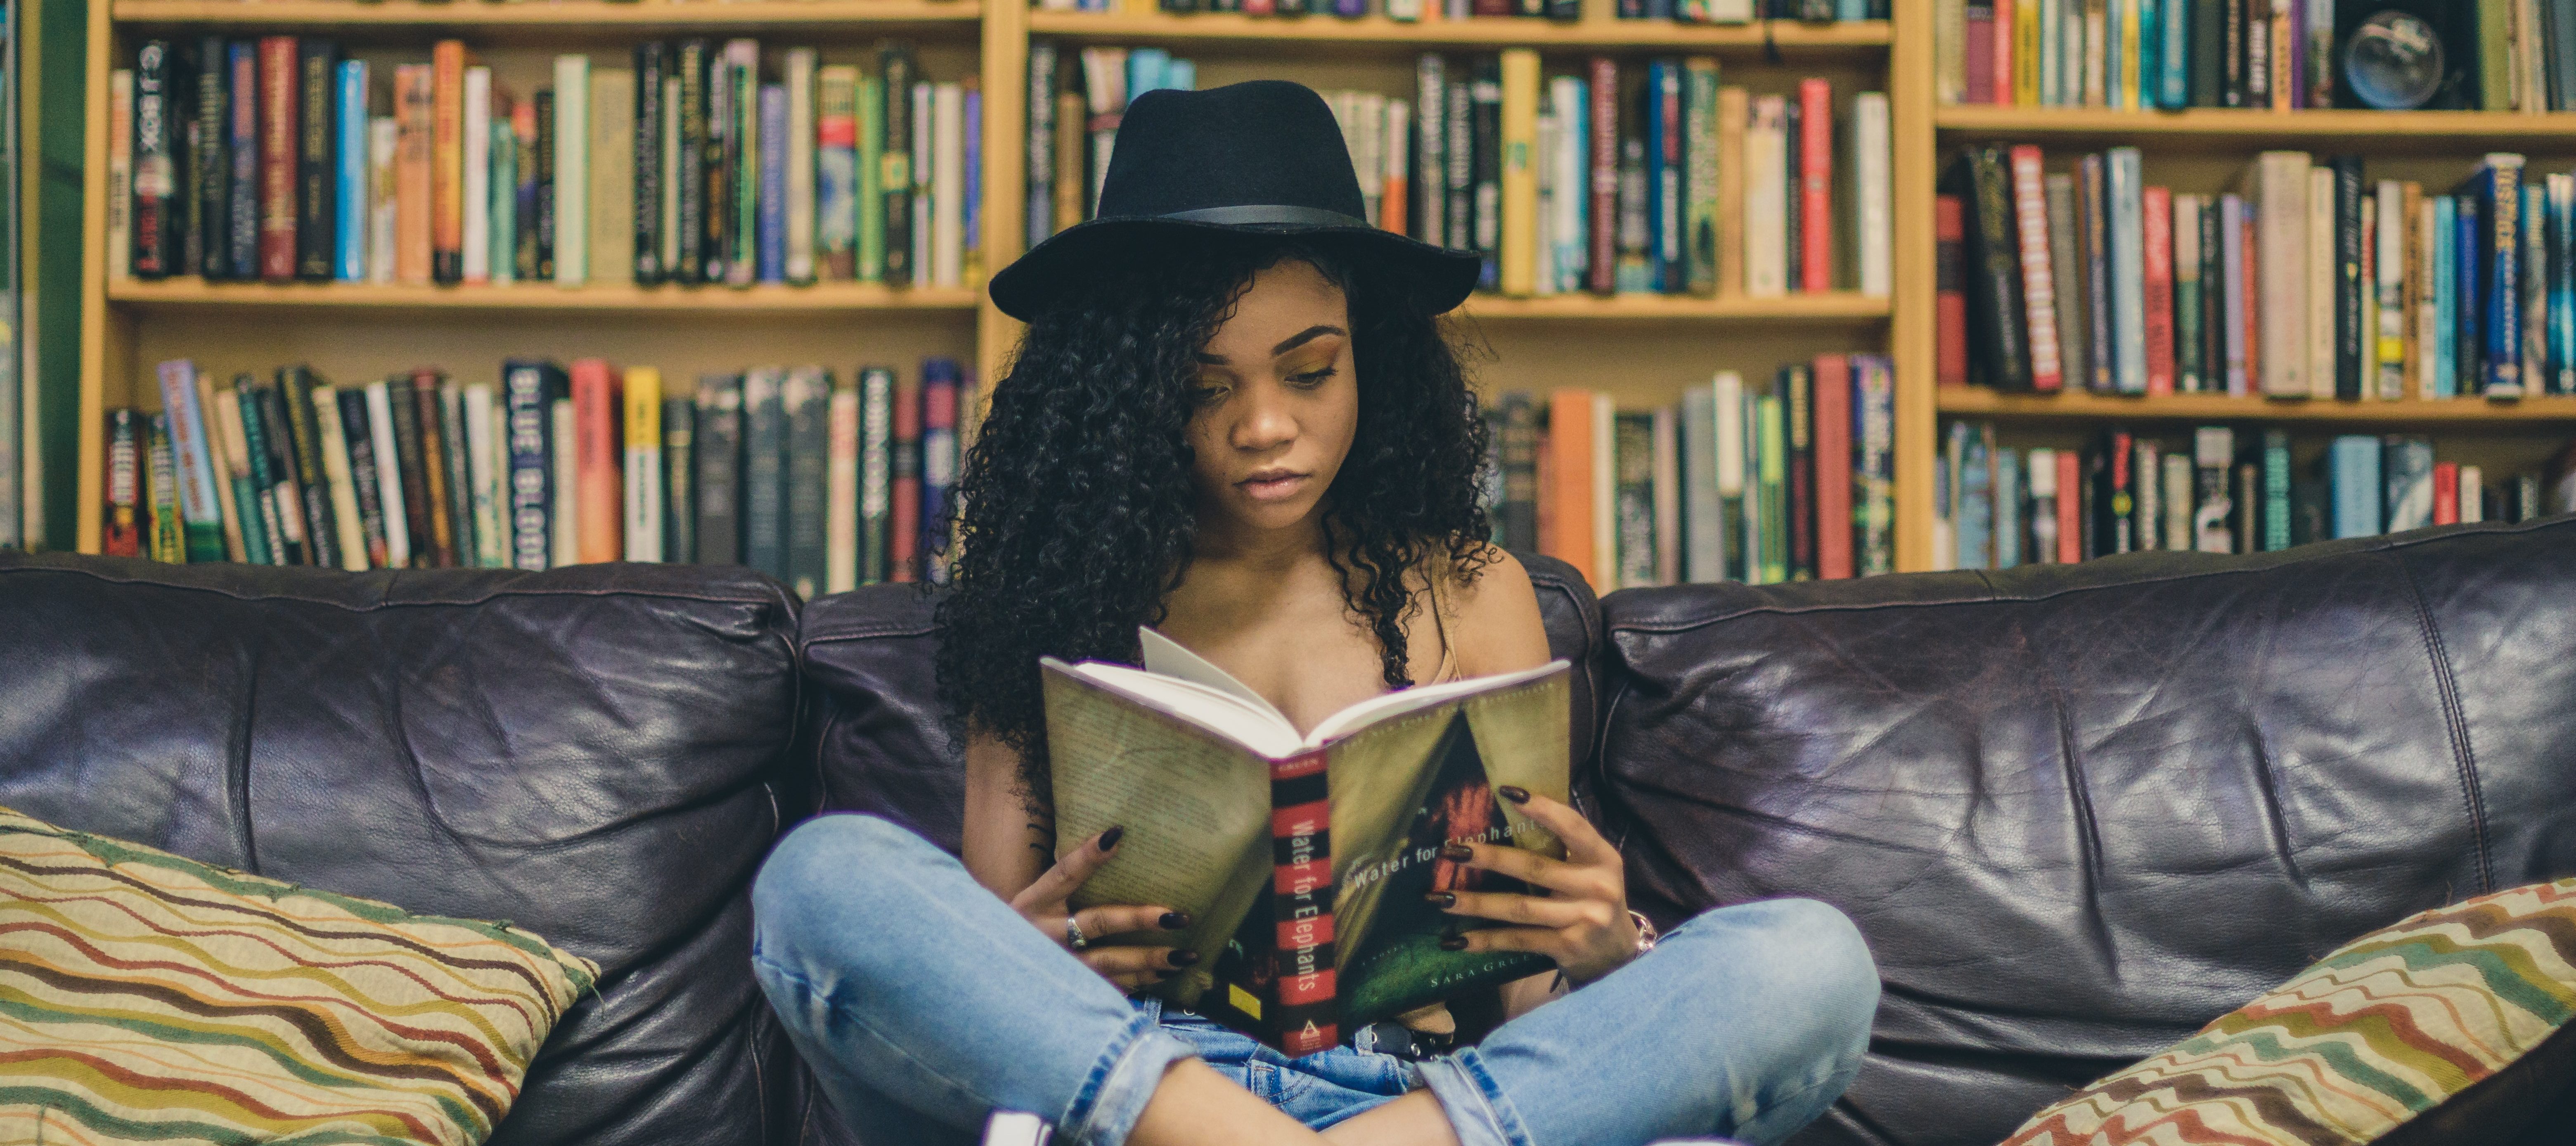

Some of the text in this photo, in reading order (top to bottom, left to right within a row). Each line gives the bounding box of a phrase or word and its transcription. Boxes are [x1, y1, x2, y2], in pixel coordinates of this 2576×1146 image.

[509, 367, 545, 572] BLUE BLOOD
[1292, 819, 1320, 991] Water for Elephants
[1354, 819, 1537, 888] Water for lephant
[1430, 954, 1543, 988] SARA GRUE
